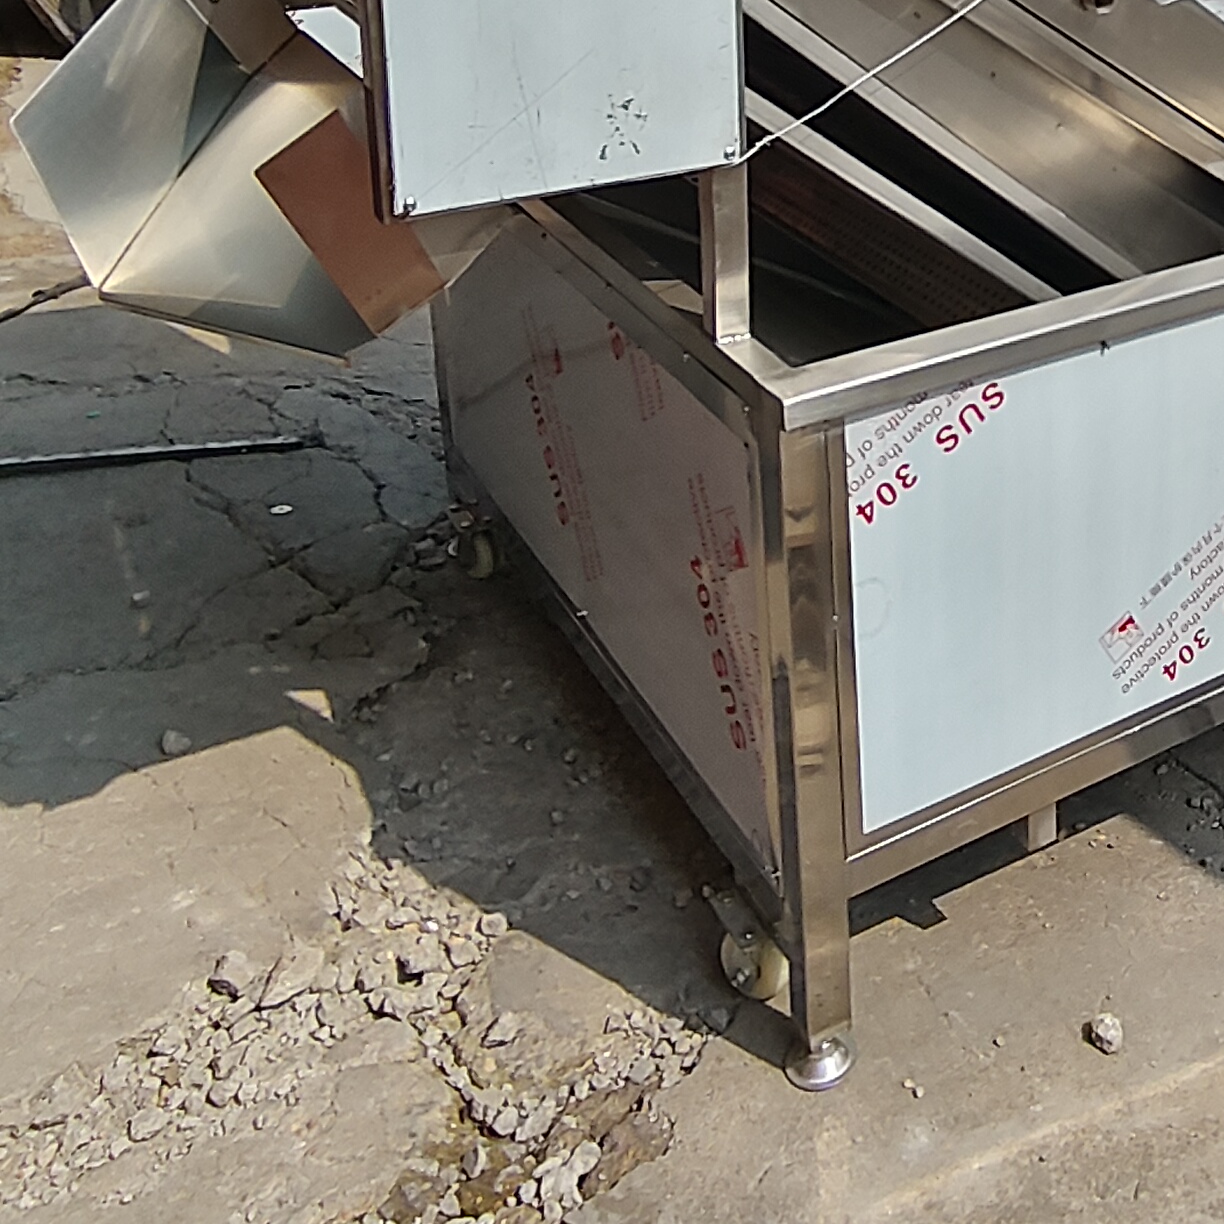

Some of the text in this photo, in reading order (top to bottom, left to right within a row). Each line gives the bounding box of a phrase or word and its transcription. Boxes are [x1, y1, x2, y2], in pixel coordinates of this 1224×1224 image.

[902, 404, 943, 444] down
[855, 381, 1005, 525] SUS 304
[857, 438, 874, 461] of
[876, 442, 904, 468] the
[1180, 565, 1224, 612] months
[1166, 611, 1179, 629] of
[1181, 612, 1202, 634] the
[1111, 624, 1167, 681] products
[1120, 632, 1181, 695] protective
[1161, 626, 1212, 682] 304
